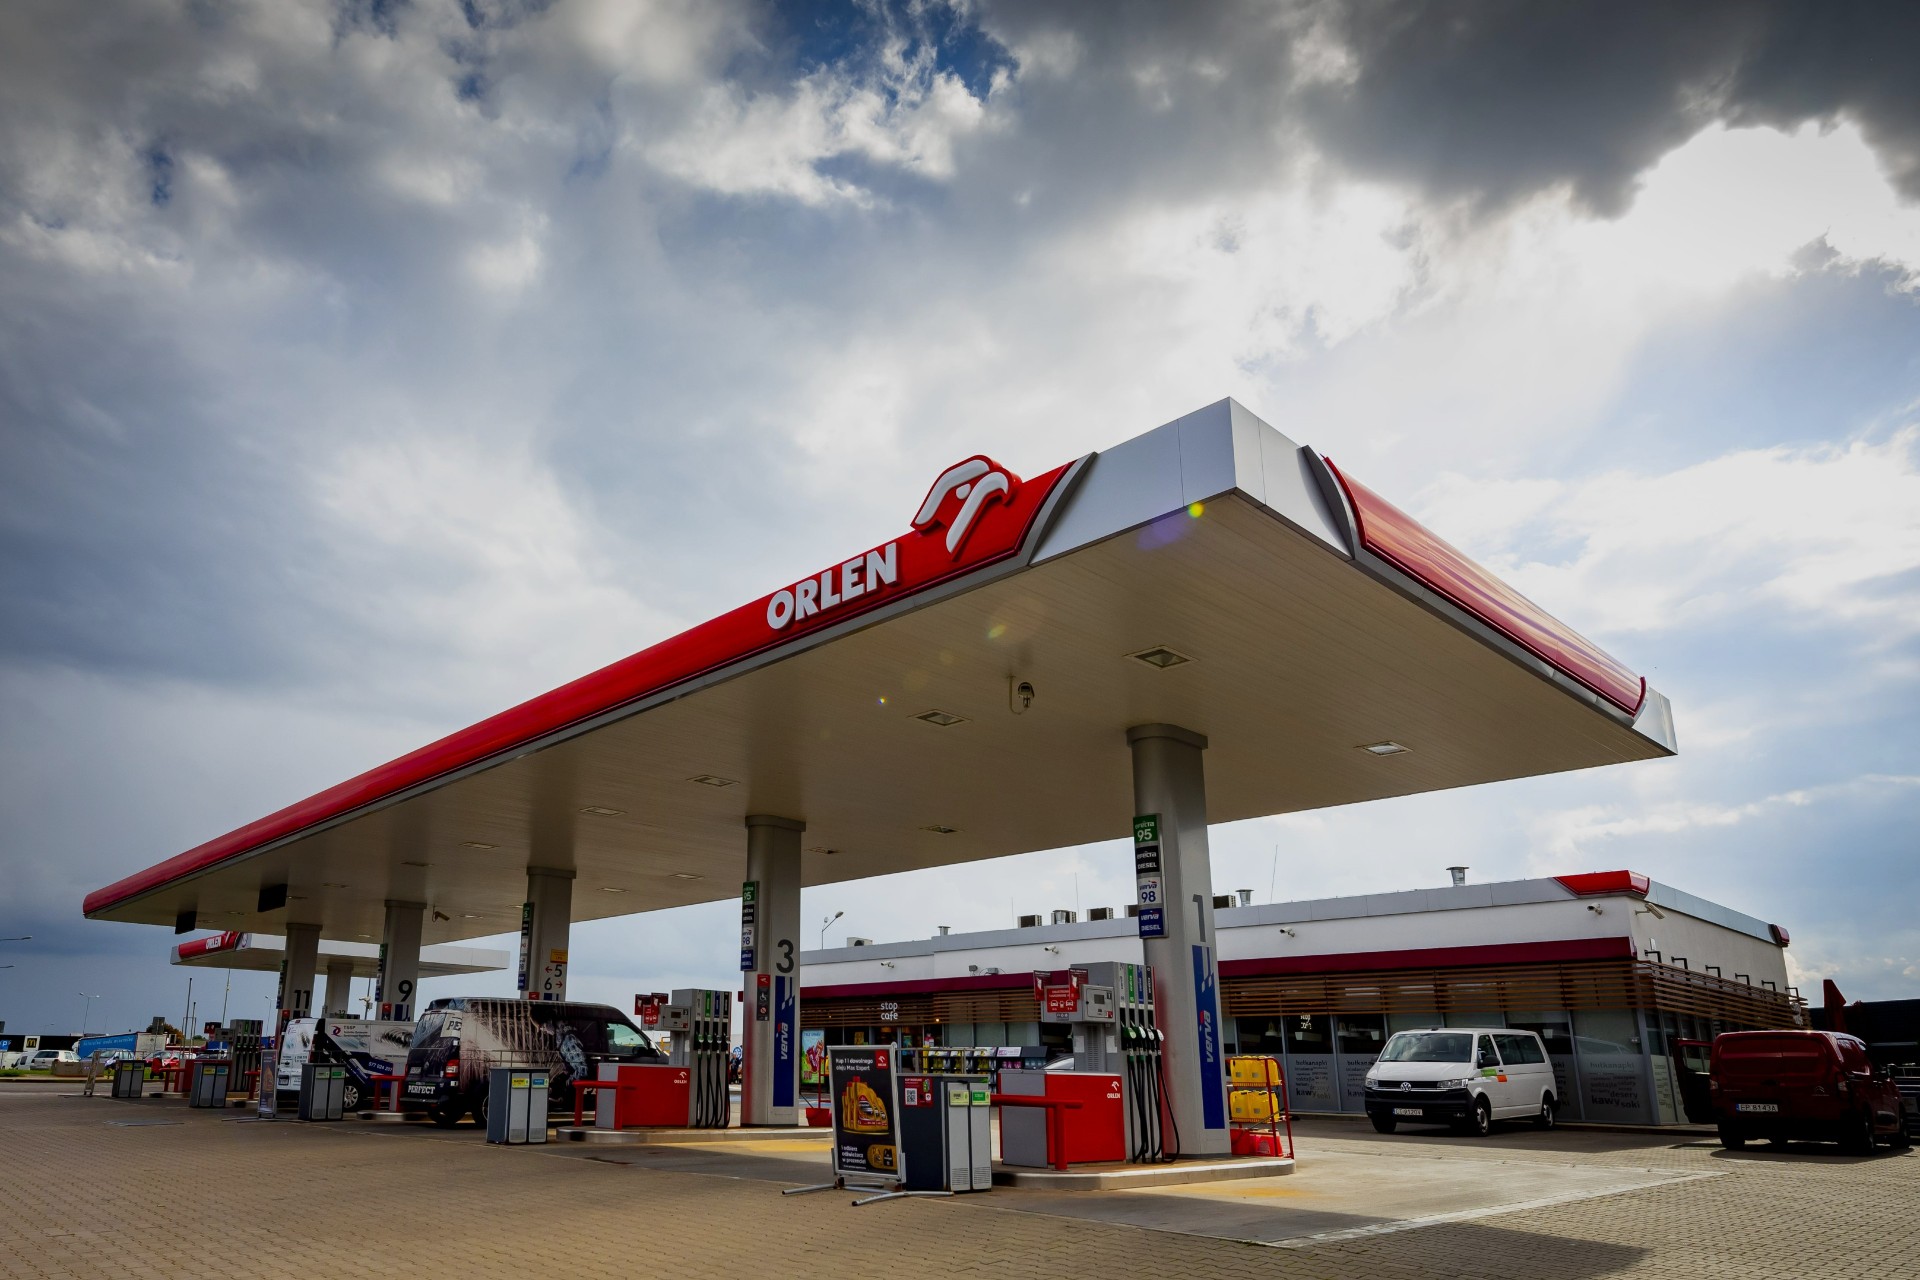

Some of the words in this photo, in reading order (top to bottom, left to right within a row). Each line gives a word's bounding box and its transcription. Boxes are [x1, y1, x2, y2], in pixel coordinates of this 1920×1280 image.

[766, 542, 897, 630] ORLEN
[1137, 829, 1152, 841] 95
[1141, 891, 1156, 903] 98
[1192, 894, 1206, 942] 1
[776, 939, 794, 973] 3
[554, 964, 562, 977] 5
[544, 978, 552, 990] 6
[399, 980, 412, 1001] 9
[294, 989, 311, 1009] 11
[880, 1001, 898, 1012] stop
[880, 1011, 898, 1021] cafe
[781, 1022, 789, 1060] verva
[1203, 1010, 1214, 1063] verva
[408, 1085, 436, 1095] PERFECT
[1591, 1095, 1620, 1106] kawy
[1621, 1100, 1640, 1108] soki
